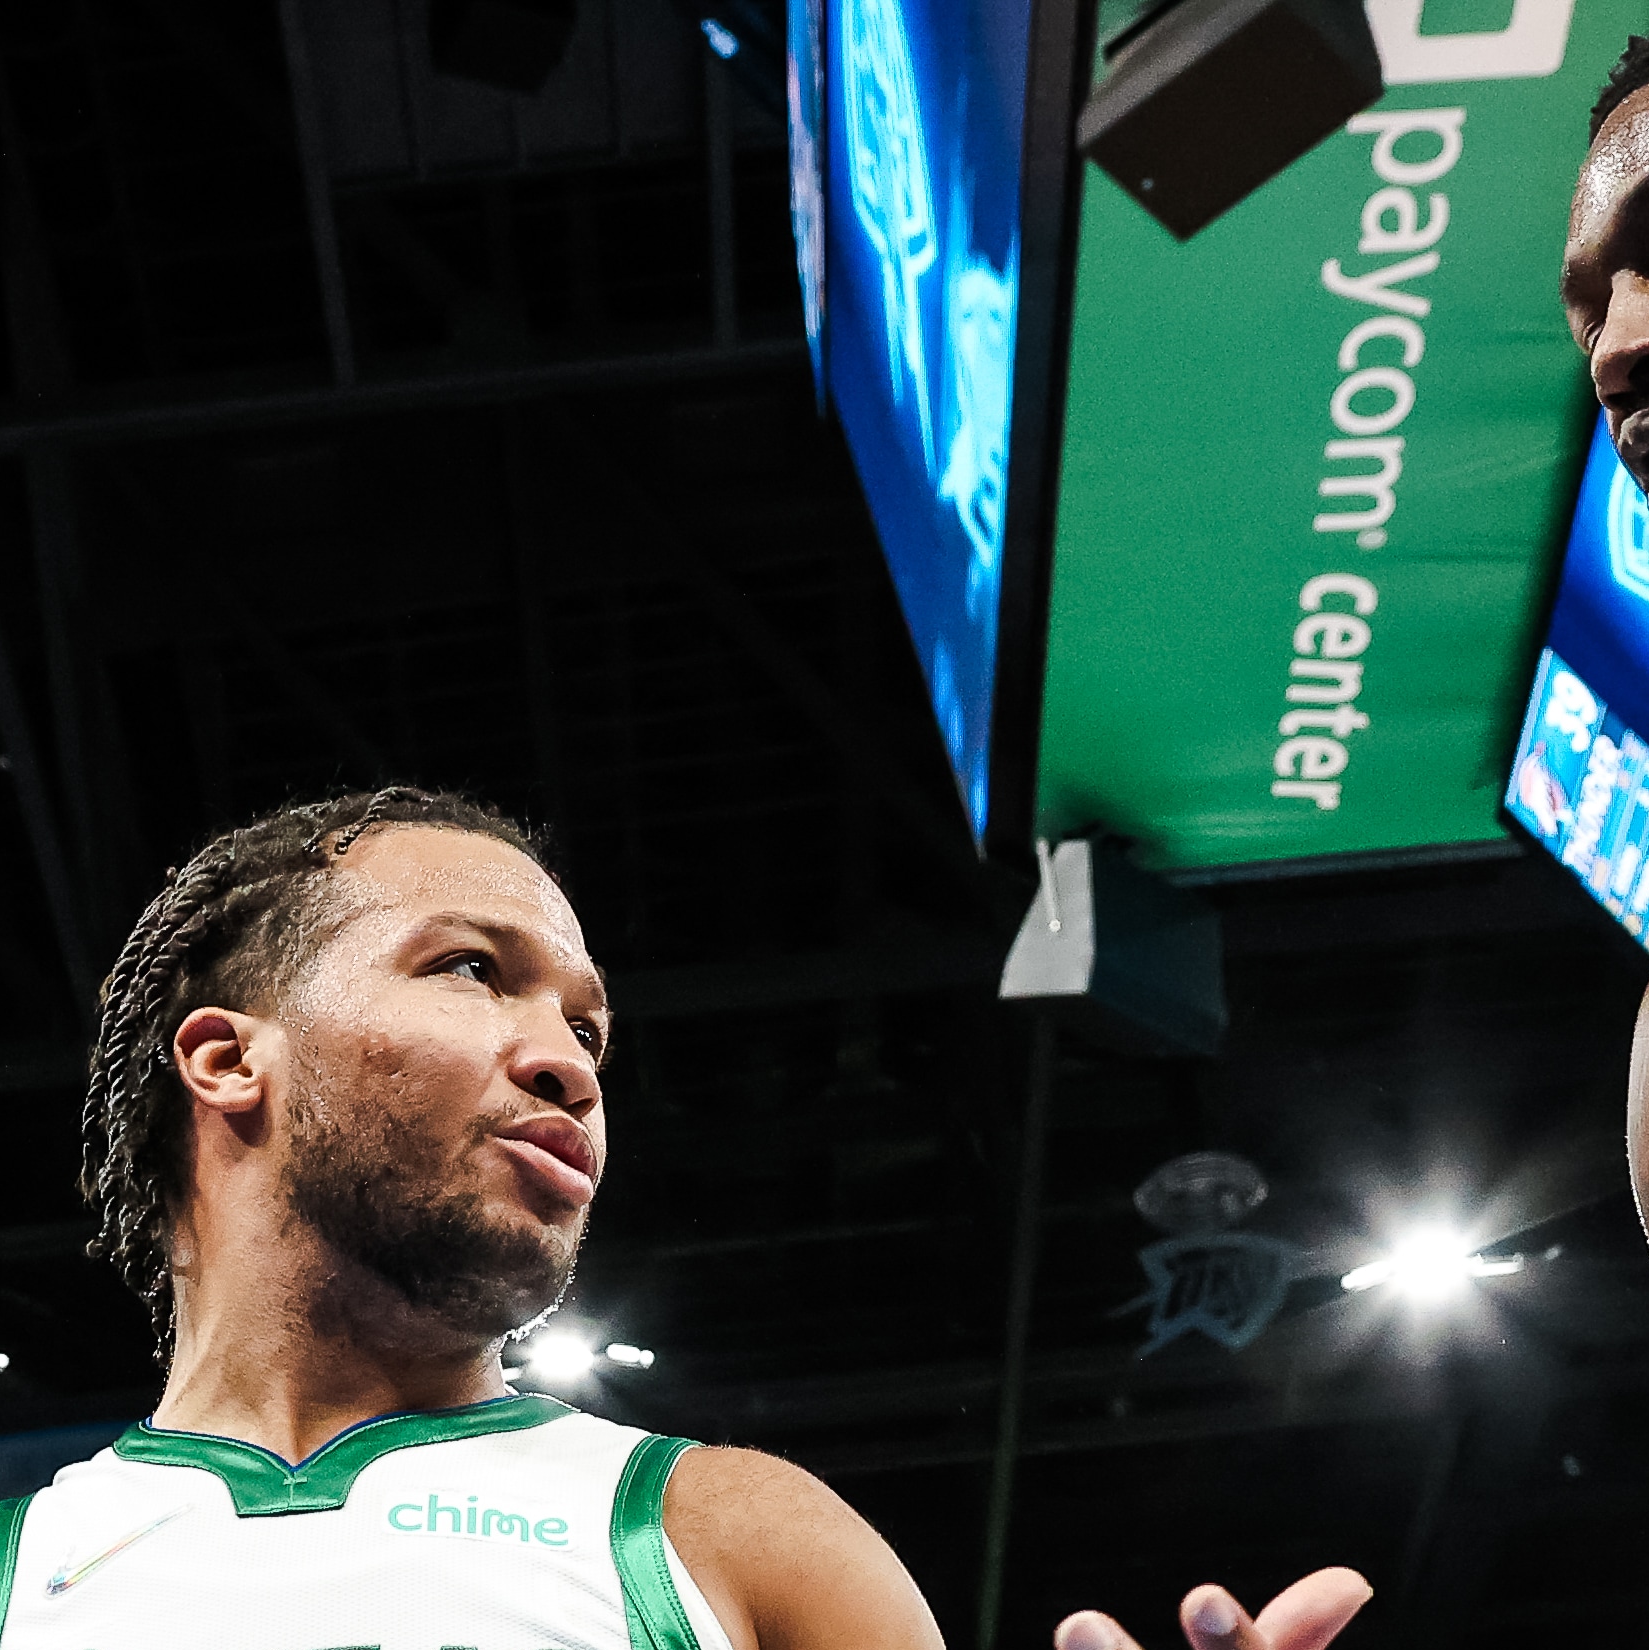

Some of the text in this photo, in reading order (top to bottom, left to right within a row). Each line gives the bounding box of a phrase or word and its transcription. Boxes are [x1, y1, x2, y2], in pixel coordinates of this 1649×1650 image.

[1271, 106, 1467, 811] paycom center
[388, 1494, 569, 1547] chime
